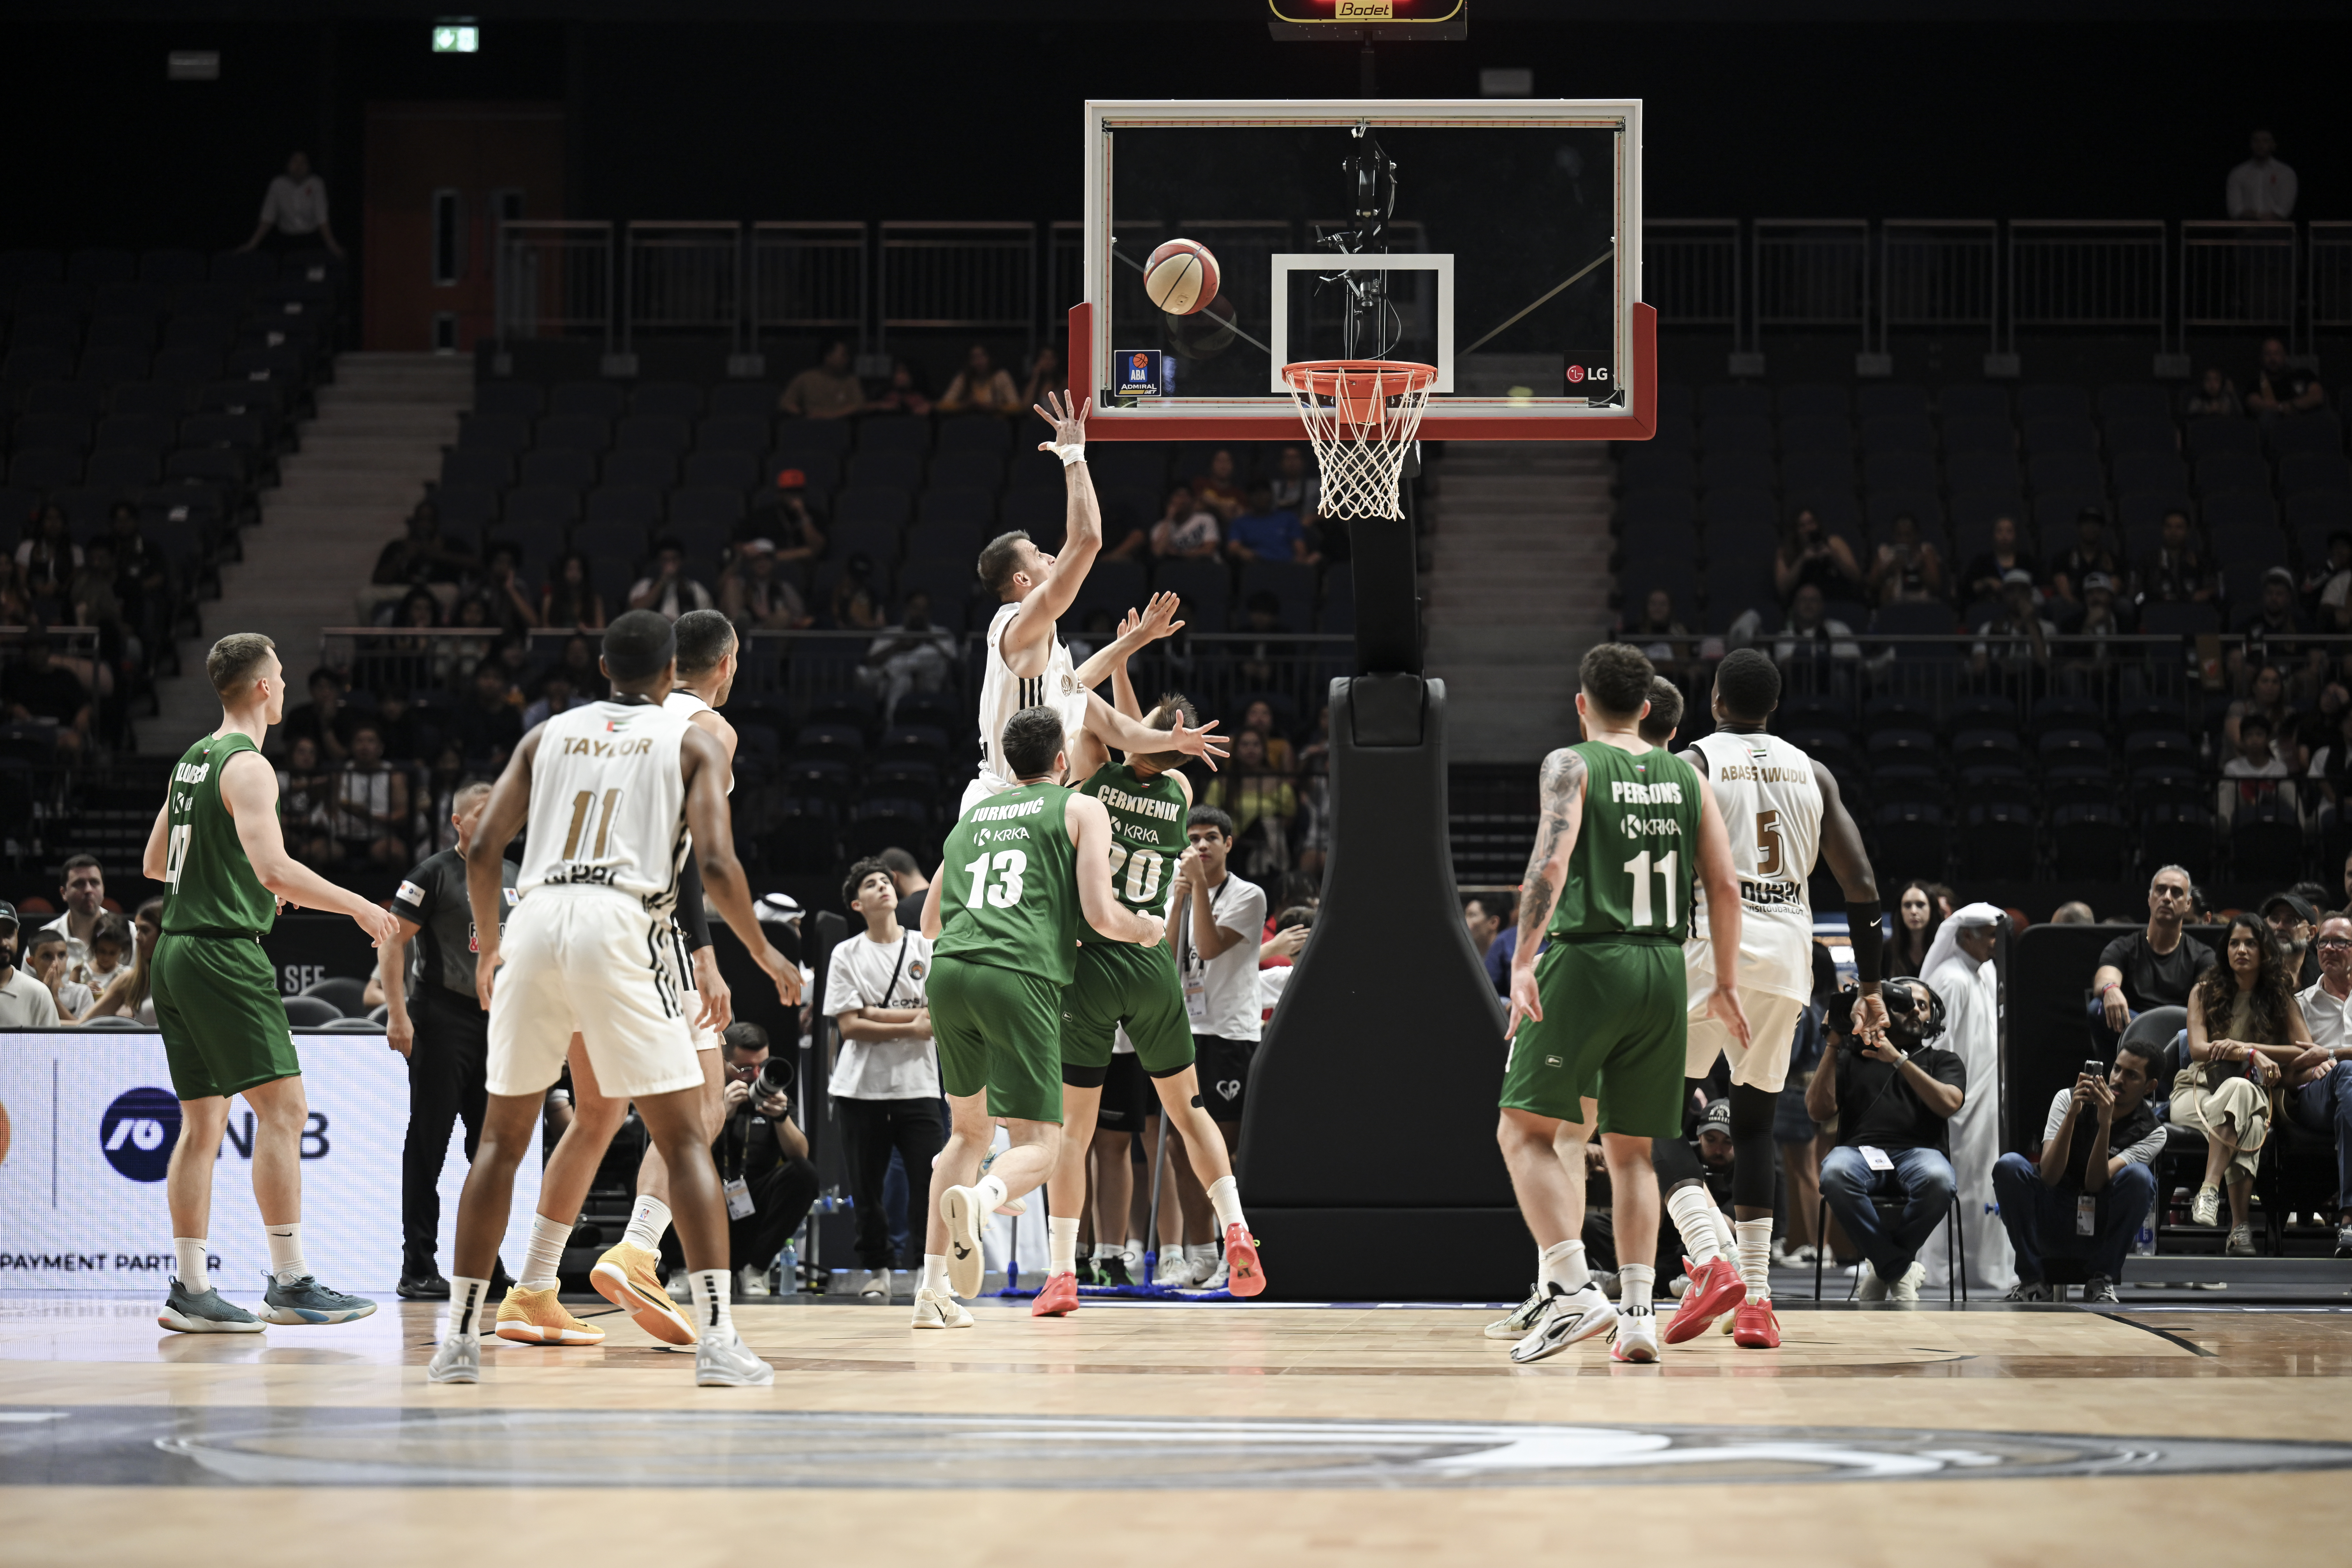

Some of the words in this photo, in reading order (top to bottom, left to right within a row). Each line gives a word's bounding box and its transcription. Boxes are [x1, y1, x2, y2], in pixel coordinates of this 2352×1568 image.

[1339, 2, 1389, 16] Bodet
[1130, 369, 1146, 380] ABA
[1588, 367, 1608, 380] LG
[564, 737, 653, 758] TAYLOR
[1721, 765, 1758, 782] ABASS
[1761, 767, 1807, 785] AWUDU
[1097, 784, 1180, 822] CERKVENIK
[1611, 781, 1683, 805] PERSONS
[970, 796, 1044, 823] JURKOVIĆ
[563, 788, 624, 865] 11
[993, 827, 1030, 841] KRKA
[1124, 823, 1159, 844] KRKA
[1642, 818, 1682, 835] KRKA
[1756, 810, 1785, 878] 5
[965, 849, 1027, 909] 13
[1624, 850, 1678, 928] 11
[1741, 881, 1801, 905] DUBAI
[217, 1111, 330, 1158] NB
[0, 1252, 107, 1271] PAYMENT
[117, 1252, 221, 1271] PARTR
